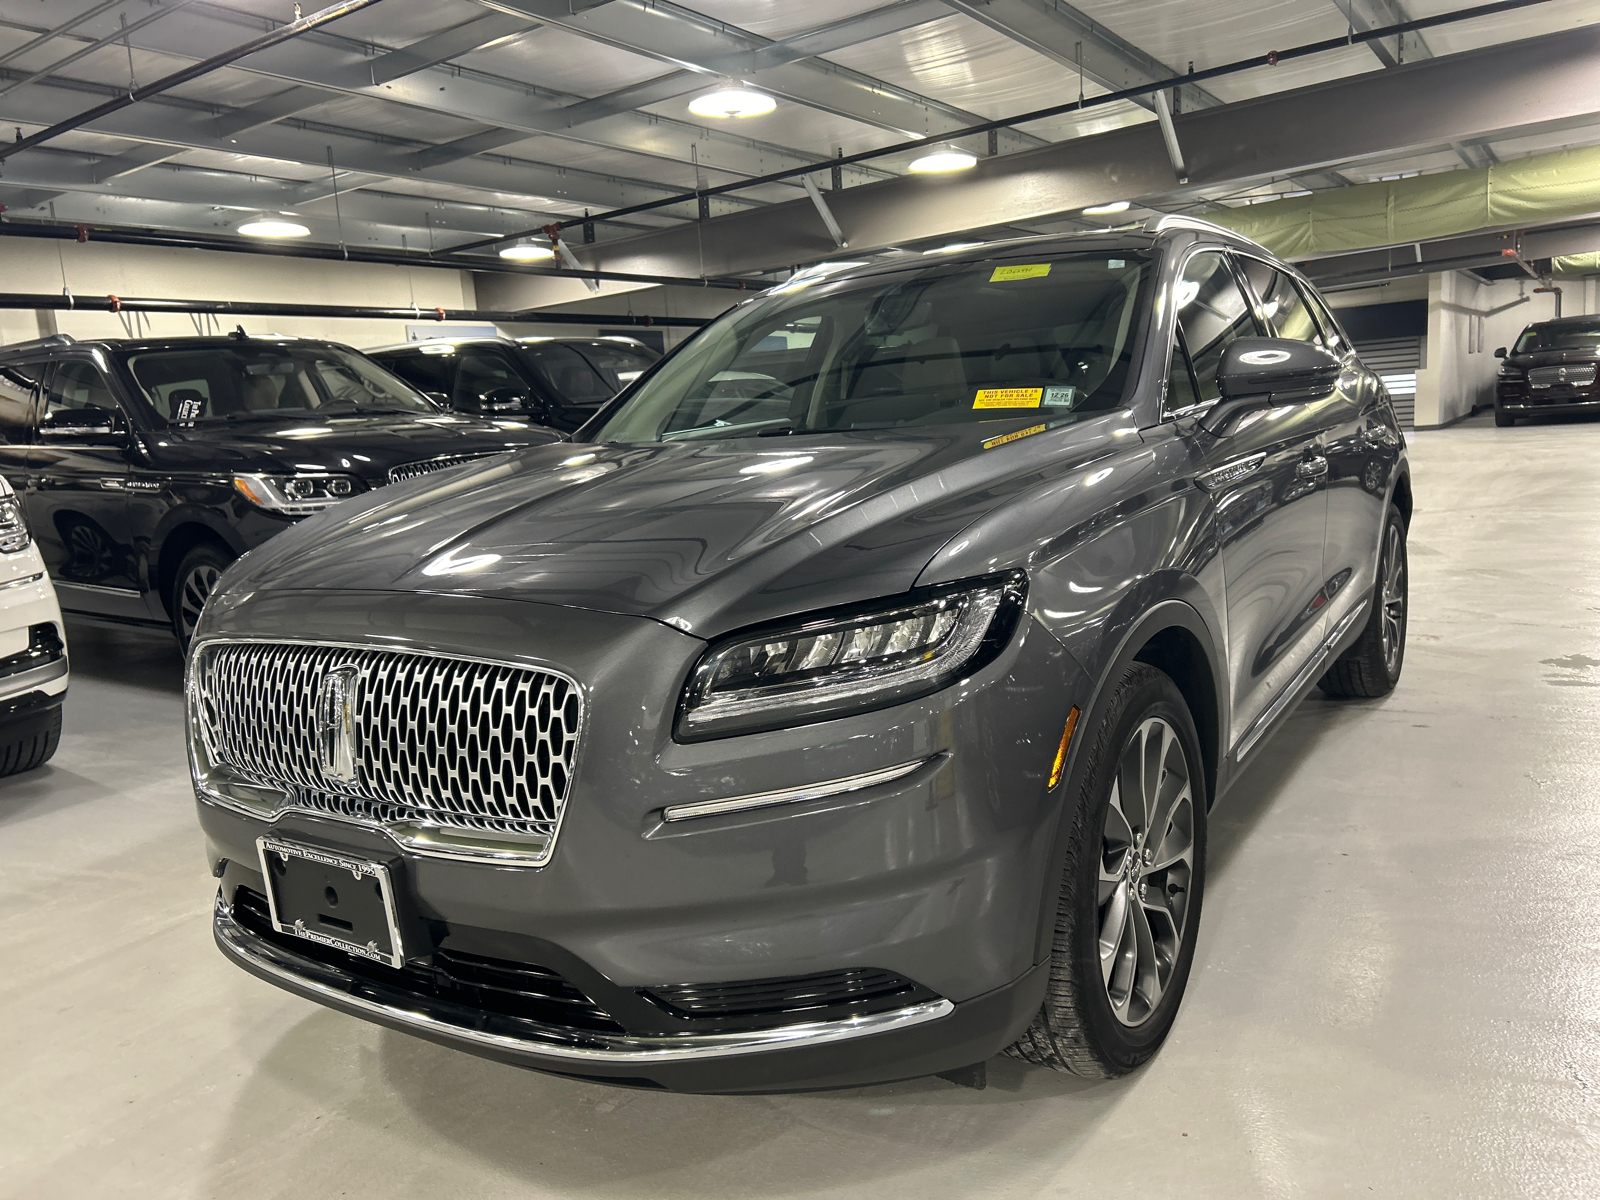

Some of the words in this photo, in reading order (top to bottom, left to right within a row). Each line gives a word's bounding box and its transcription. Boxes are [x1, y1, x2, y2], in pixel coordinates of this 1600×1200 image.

[266, 842, 303, 857] AUTOMOTIVE
[303, 851, 338, 865] EXCELLENCE
[339, 859, 357, 870] SINCE
[357, 864, 375, 875] 1995
